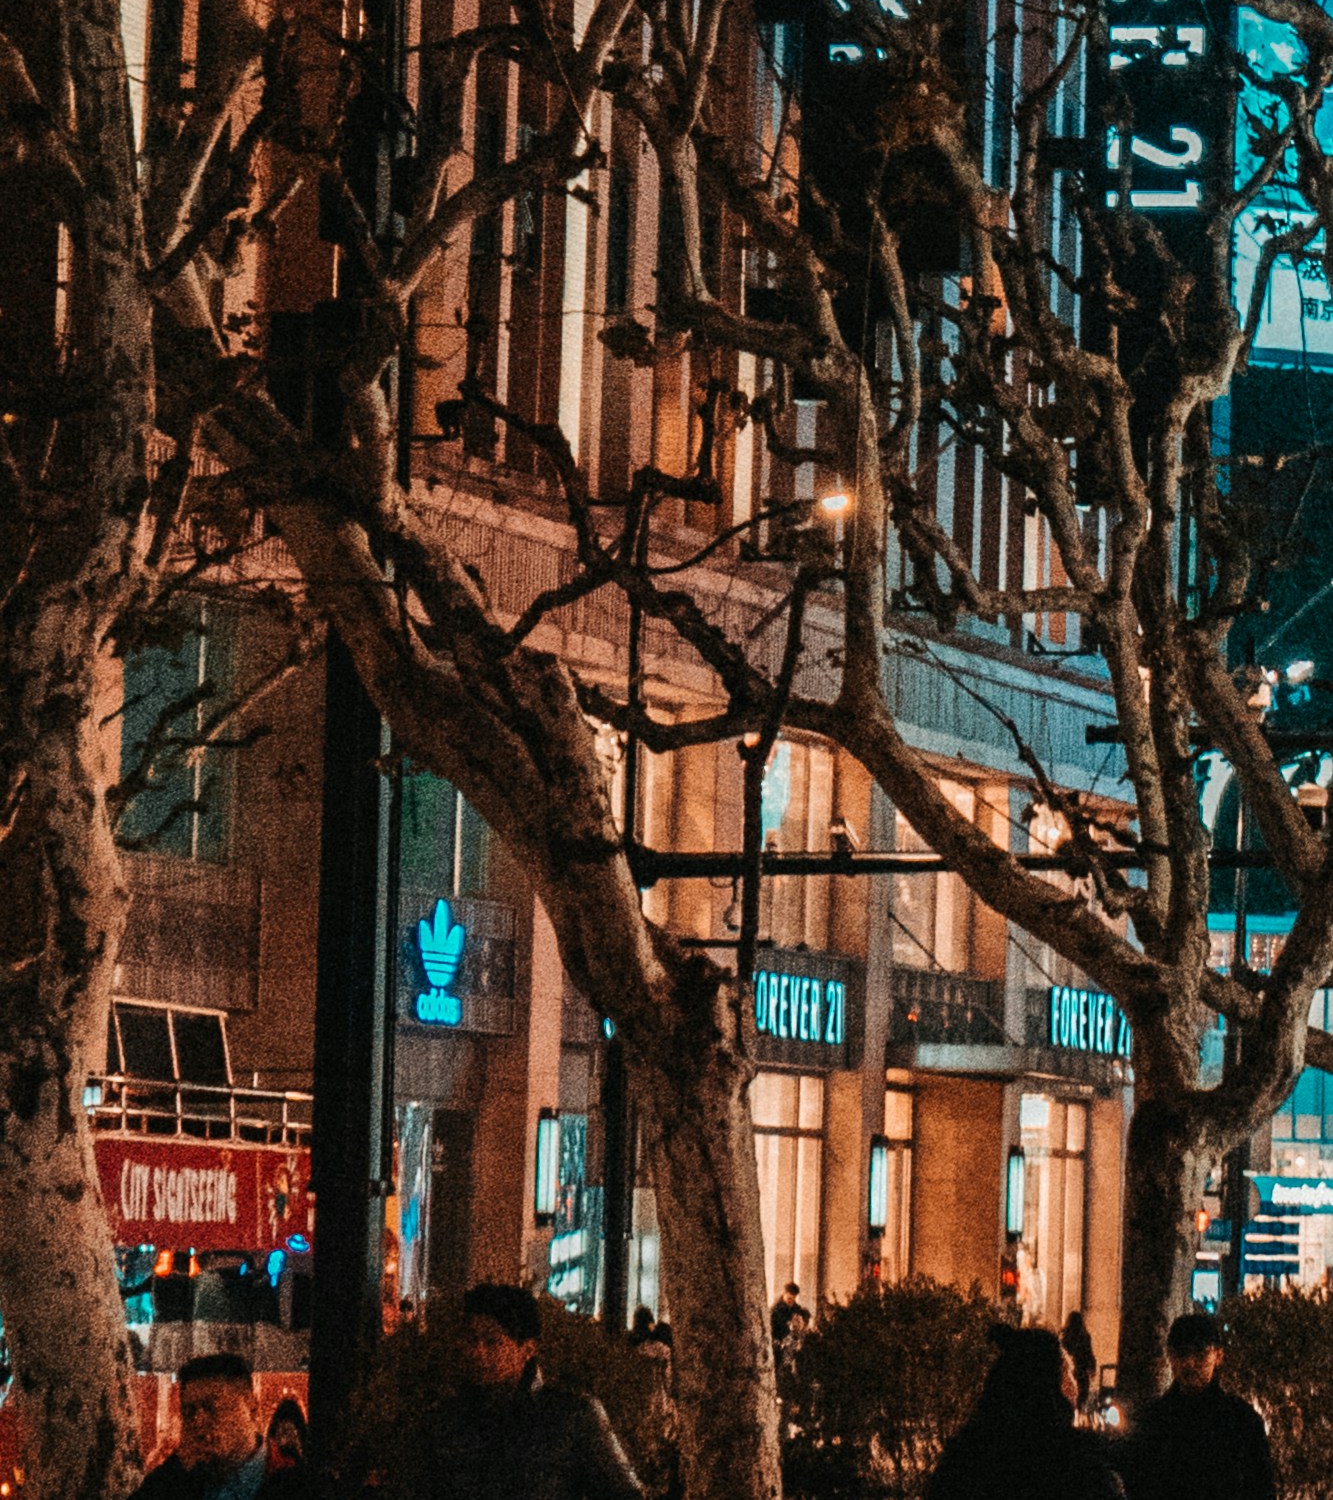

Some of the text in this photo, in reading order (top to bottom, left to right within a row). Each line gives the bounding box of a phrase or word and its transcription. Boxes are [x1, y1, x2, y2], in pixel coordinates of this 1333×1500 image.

[1106, 124, 1204, 213] 21
[751, 970, 846, 1045] OREVER 21
[1051, 984, 1114, 1055] FOREVER
